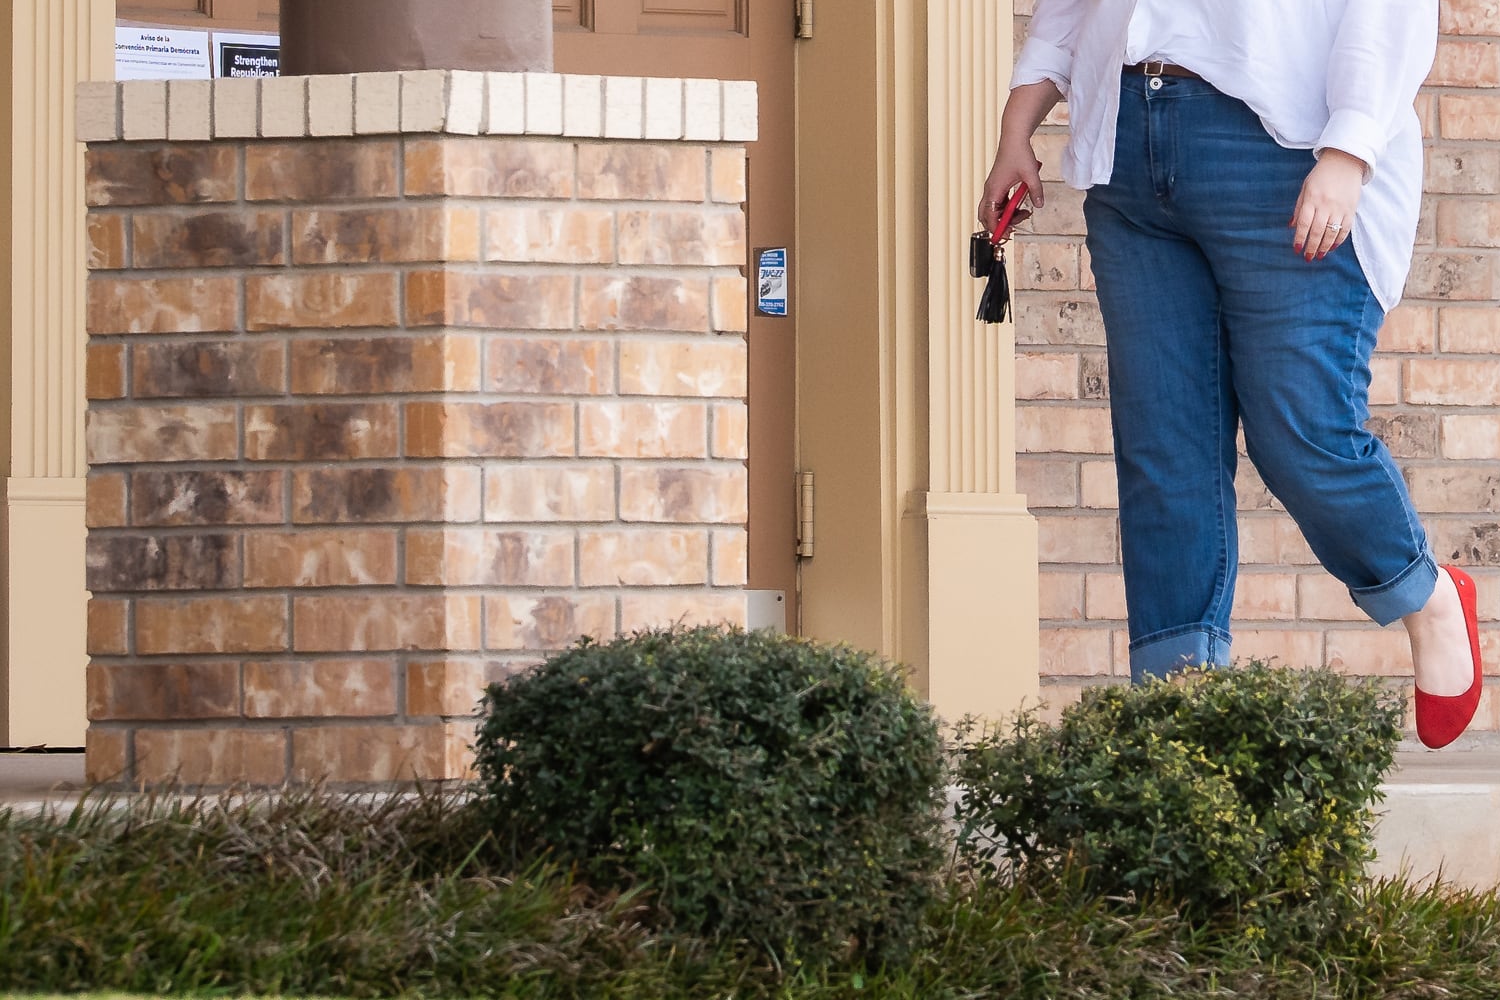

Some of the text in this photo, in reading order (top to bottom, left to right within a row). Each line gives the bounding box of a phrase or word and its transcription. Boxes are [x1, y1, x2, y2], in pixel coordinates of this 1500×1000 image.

[140, 34, 155, 42] Aviso
[145, 45, 169, 53] Primaria
[234, 54, 278, 69] Strengthen
